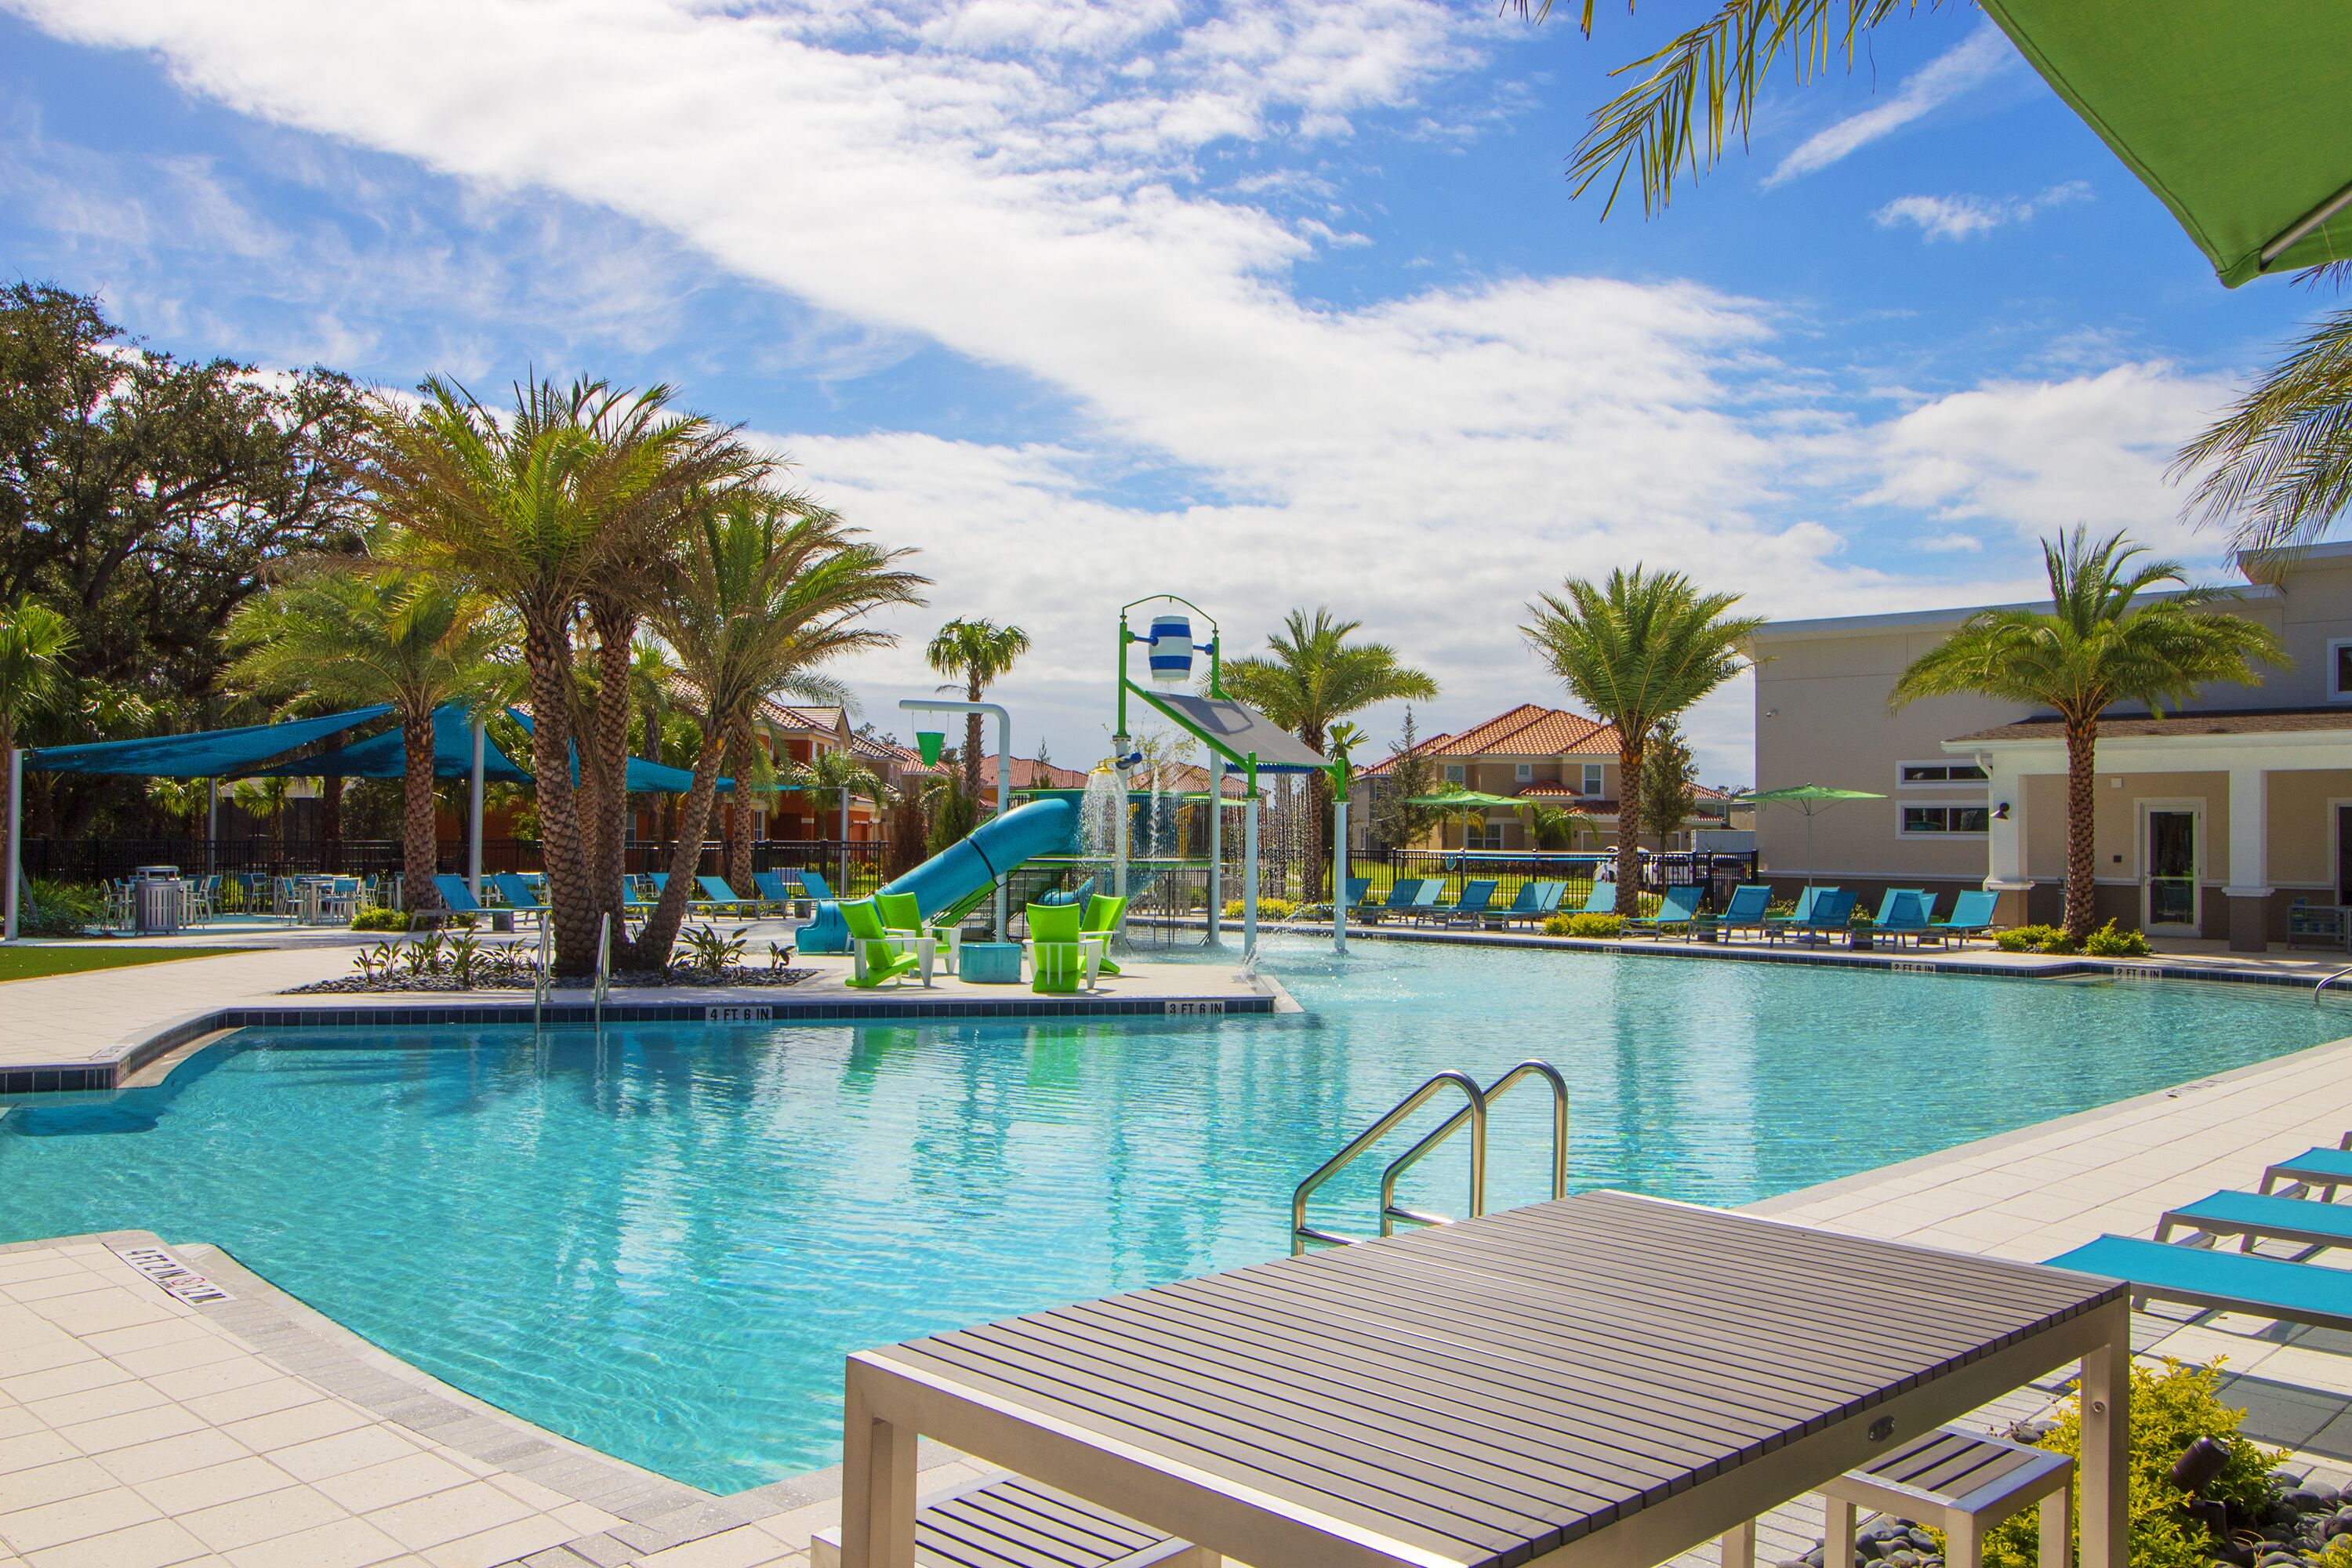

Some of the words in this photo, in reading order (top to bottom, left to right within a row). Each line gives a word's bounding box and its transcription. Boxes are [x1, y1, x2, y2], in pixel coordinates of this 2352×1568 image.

[2150, 970, 2159, 978] IN
[710, 1008, 717, 1020] 4
[744, 1008, 751, 1020] 6
[1170, 1004, 1176, 1014] 3
[1199, 1004, 1206, 1014] 6
